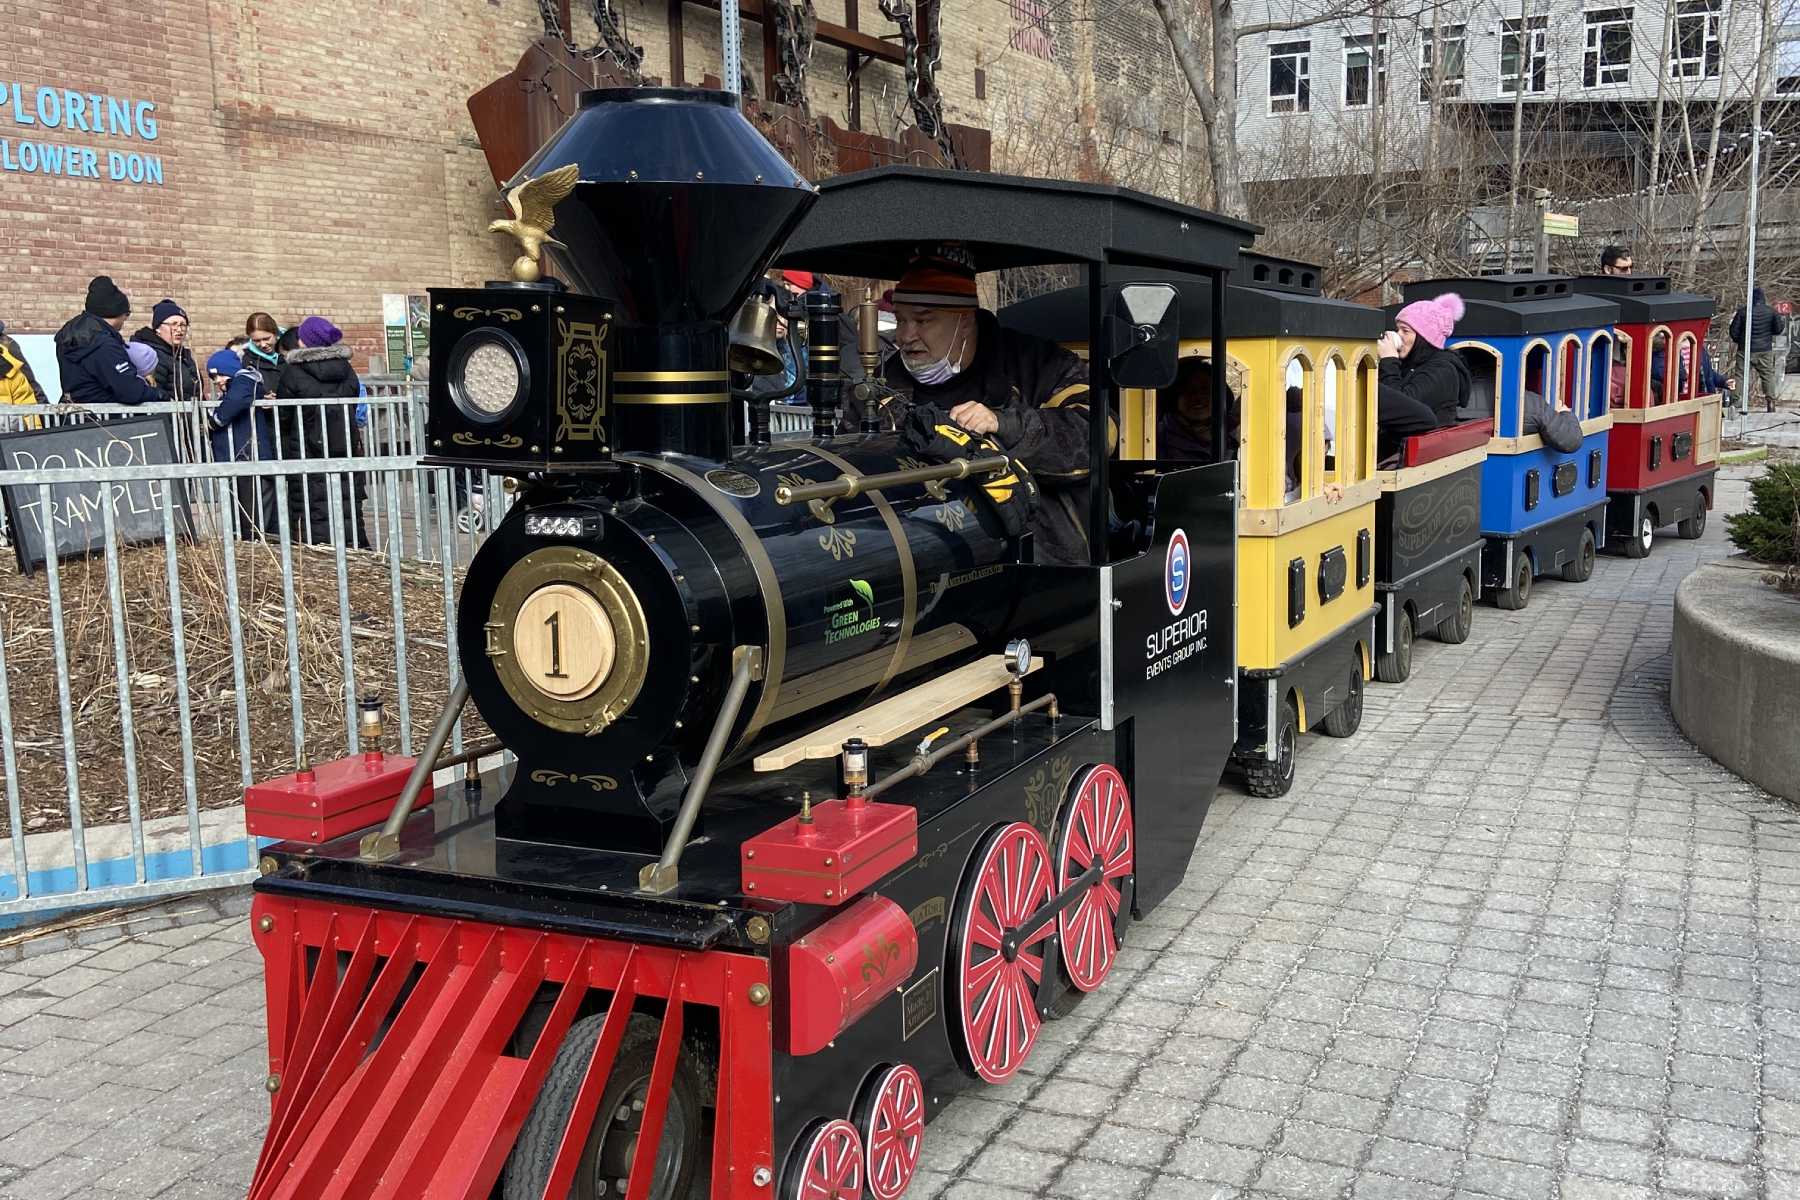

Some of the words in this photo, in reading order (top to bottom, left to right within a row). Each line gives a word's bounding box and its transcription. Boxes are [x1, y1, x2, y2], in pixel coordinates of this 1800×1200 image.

[1, 138, 100, 179] LOWER
[109, 151, 164, 185] DON
[74, 432, 158, 468] NOT
[19, 479, 181, 533] TRAMPLE
[1172, 556, 1184, 592] S
[544, 611, 569, 678] 1
[1146, 609, 1208, 659] SUPERIOR
[1146, 655, 1172, 680] EVENTS
[1172, 642, 1195, 665] GROUP
[1195, 636, 1208, 653] INC.
